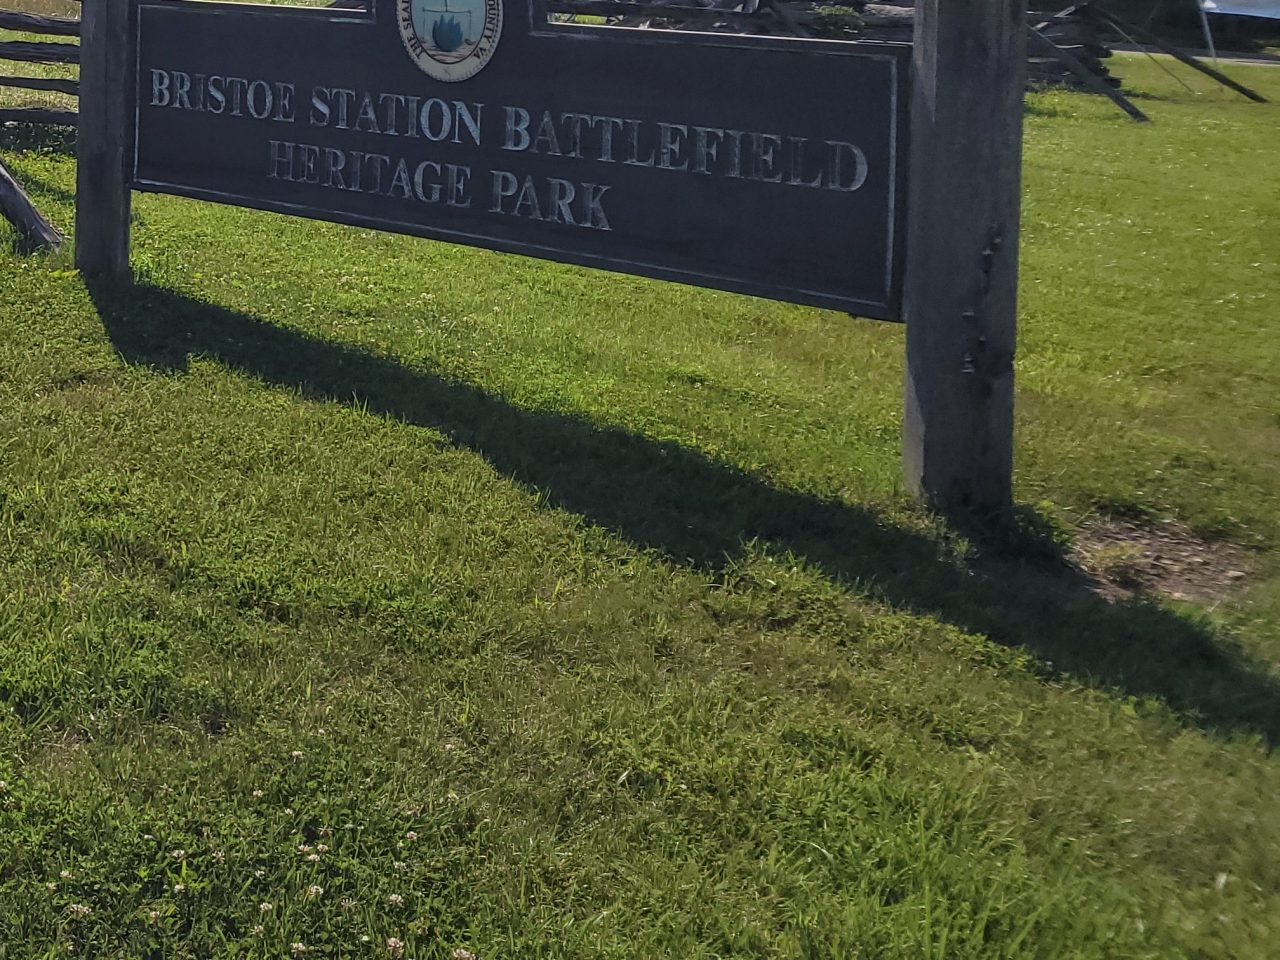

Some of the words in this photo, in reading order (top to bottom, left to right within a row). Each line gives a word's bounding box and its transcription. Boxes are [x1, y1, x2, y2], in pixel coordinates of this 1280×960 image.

[407, 33, 423, 59] THE
[150, 68, 295, 123] BRISTOE
[310, 86, 485, 146] STATION
[501, 105, 869, 192] BATTLEFIELD
[268, 140, 470, 208] HERITAGE
[488, 169, 614, 231] PARK
